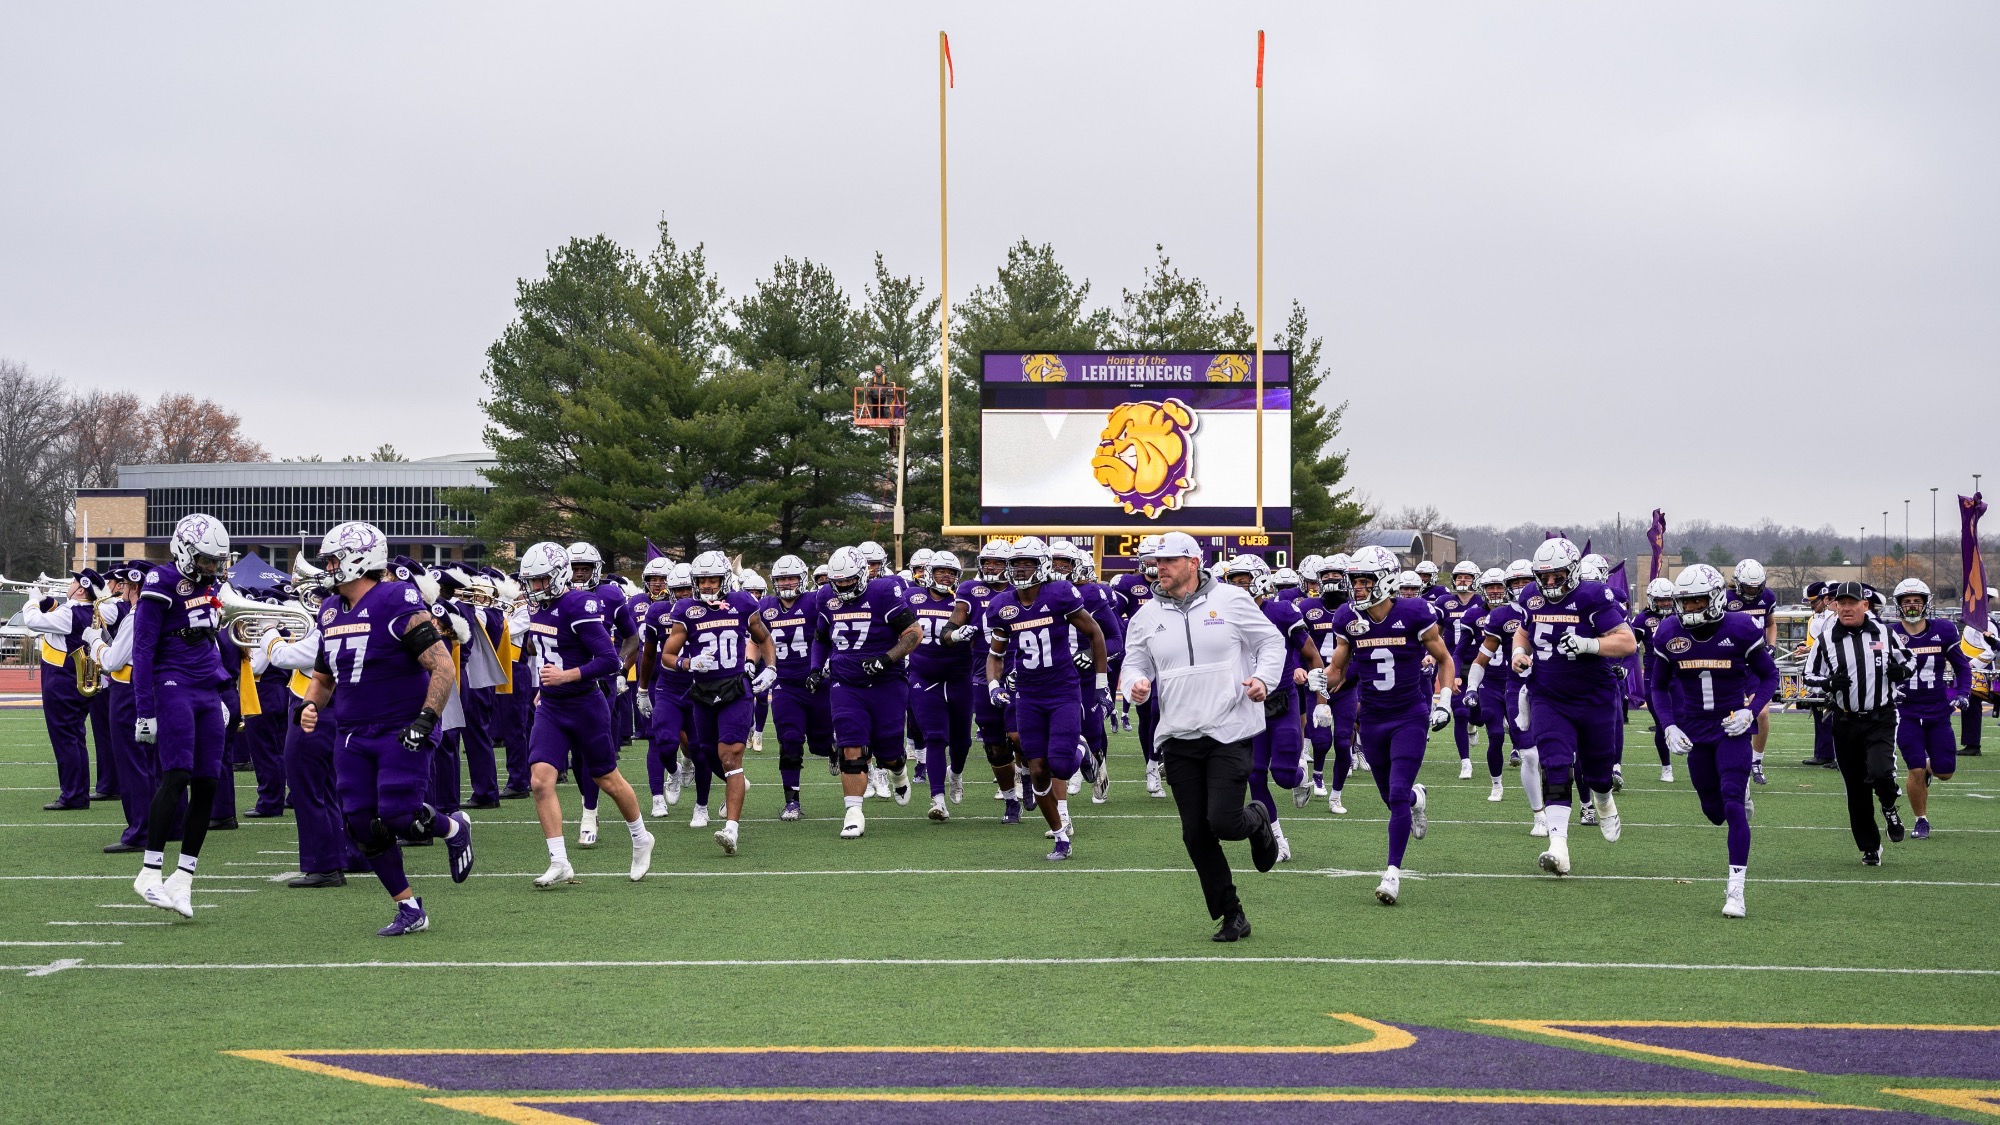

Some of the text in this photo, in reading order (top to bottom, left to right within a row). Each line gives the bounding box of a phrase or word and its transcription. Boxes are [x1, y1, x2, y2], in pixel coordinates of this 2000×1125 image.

[1106, 355, 1167, 367] Home of the
[1081, 365, 1192, 381] LEATHERNECKS
[1211, 536, 1223, 547] QTR
[1246, 536, 1269, 546] WEBB
[1276, 551, 1287, 568] 0
[695, 618, 739, 631] LEATHERNECKS
[1010, 616, 1054, 631] LEATHERNECKS
[1532, 614, 1580, 624] LEATHERNECKS
[324, 622, 371, 637] LEATHERNECKS
[832, 620, 872, 651] 67
[1018, 627, 1053, 670] 91
[1355, 636, 1407, 648] LEATHERNECKS
[1671, 641, 1687, 650] OVC
[698, 629, 739, 671] 20
[324, 635, 370, 684] 77
[1678, 659, 1732, 670] LEATHERNECKS
[1875, 656, 1882, 667] S
[1370, 648, 1396, 691] 3
[1698, 670, 1715, 711] 1
